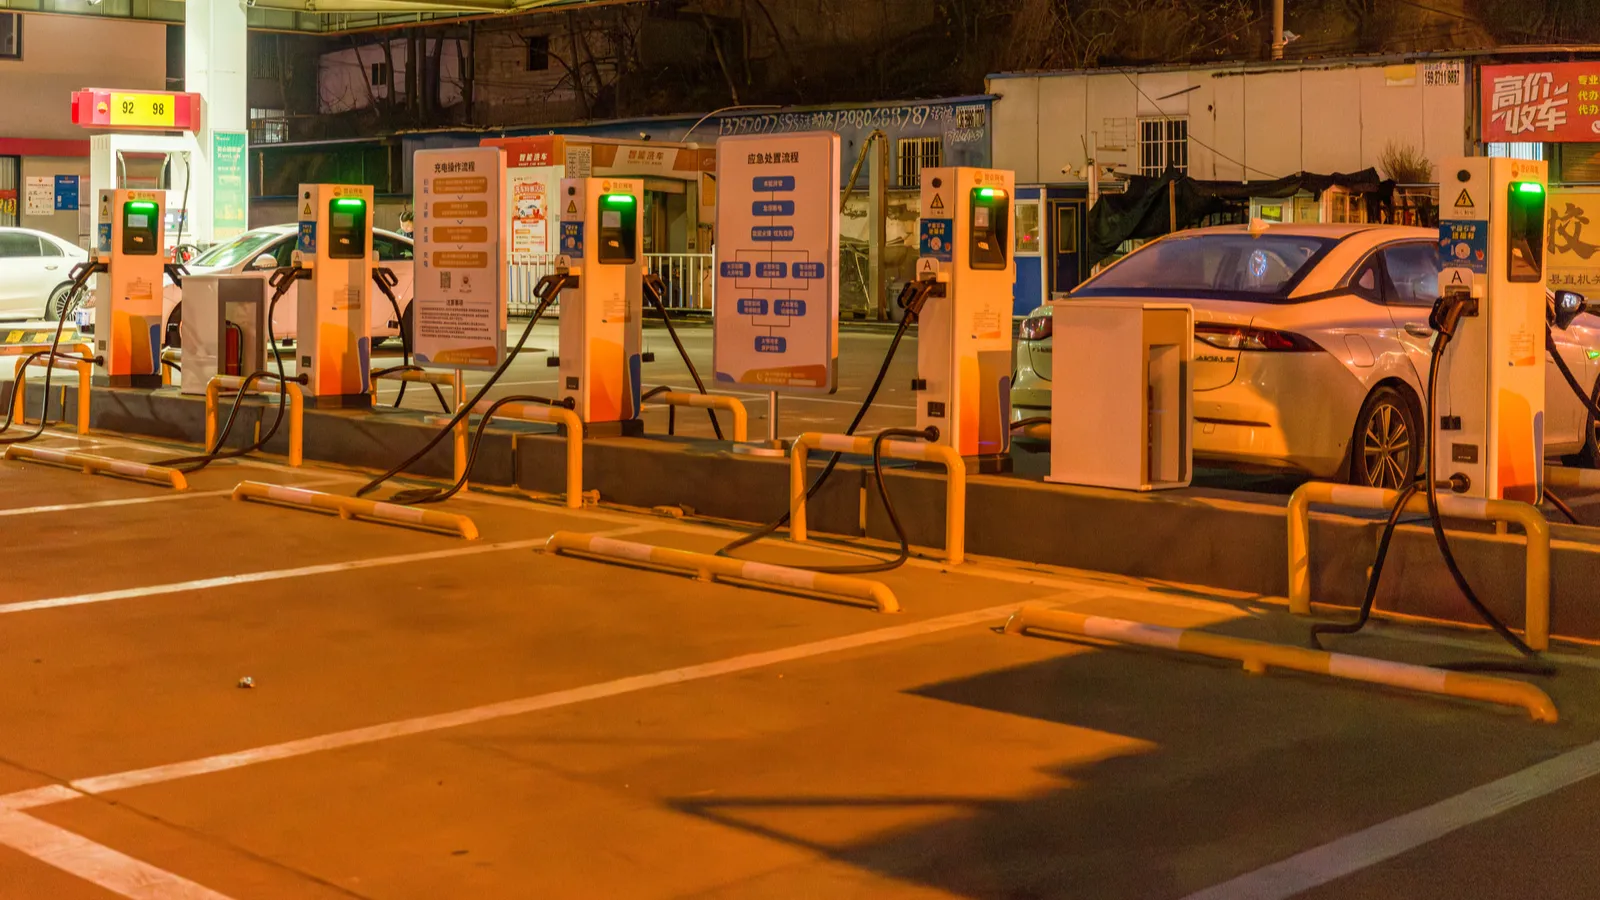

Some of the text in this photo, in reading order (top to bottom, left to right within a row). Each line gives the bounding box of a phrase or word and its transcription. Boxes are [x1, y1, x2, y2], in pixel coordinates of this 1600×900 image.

[1578, 75, 1600, 85] 专业
[1492, 72, 1553, 111] 高价
[1578, 90, 1599, 101] 代办
[122, 101, 164, 115] 92 98
[1578, 104, 1599, 115] 代办
[1494, 98, 1568, 134] 收车
[519, 152, 548, 162] 智能洗车
[628, 150, 664, 161] 智能洗车
[748, 151, 799, 165] 应急处置流程
[434, 161, 475, 173] 充电操作流程
[1547, 202, 1600, 260] 校
[559, 257, 565, 265] A
[923, 259, 931, 270] A
[1451, 270, 1463, 284] A
